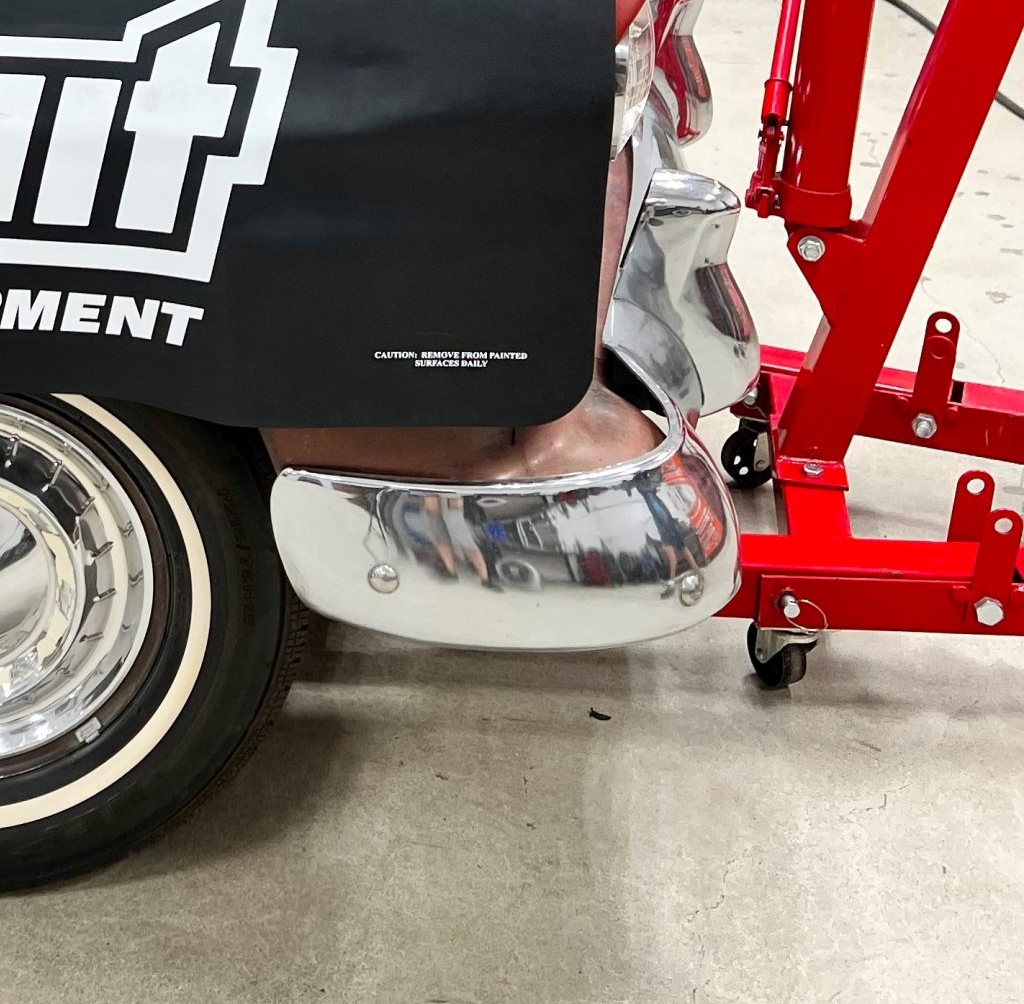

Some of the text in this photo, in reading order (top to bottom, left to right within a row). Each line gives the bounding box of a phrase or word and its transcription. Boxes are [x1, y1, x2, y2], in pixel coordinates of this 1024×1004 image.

[374, 351, 528, 360] CAUTION: REMOVE FROM PAINTED
[414, 359, 489, 368] SURFACES DAILY
